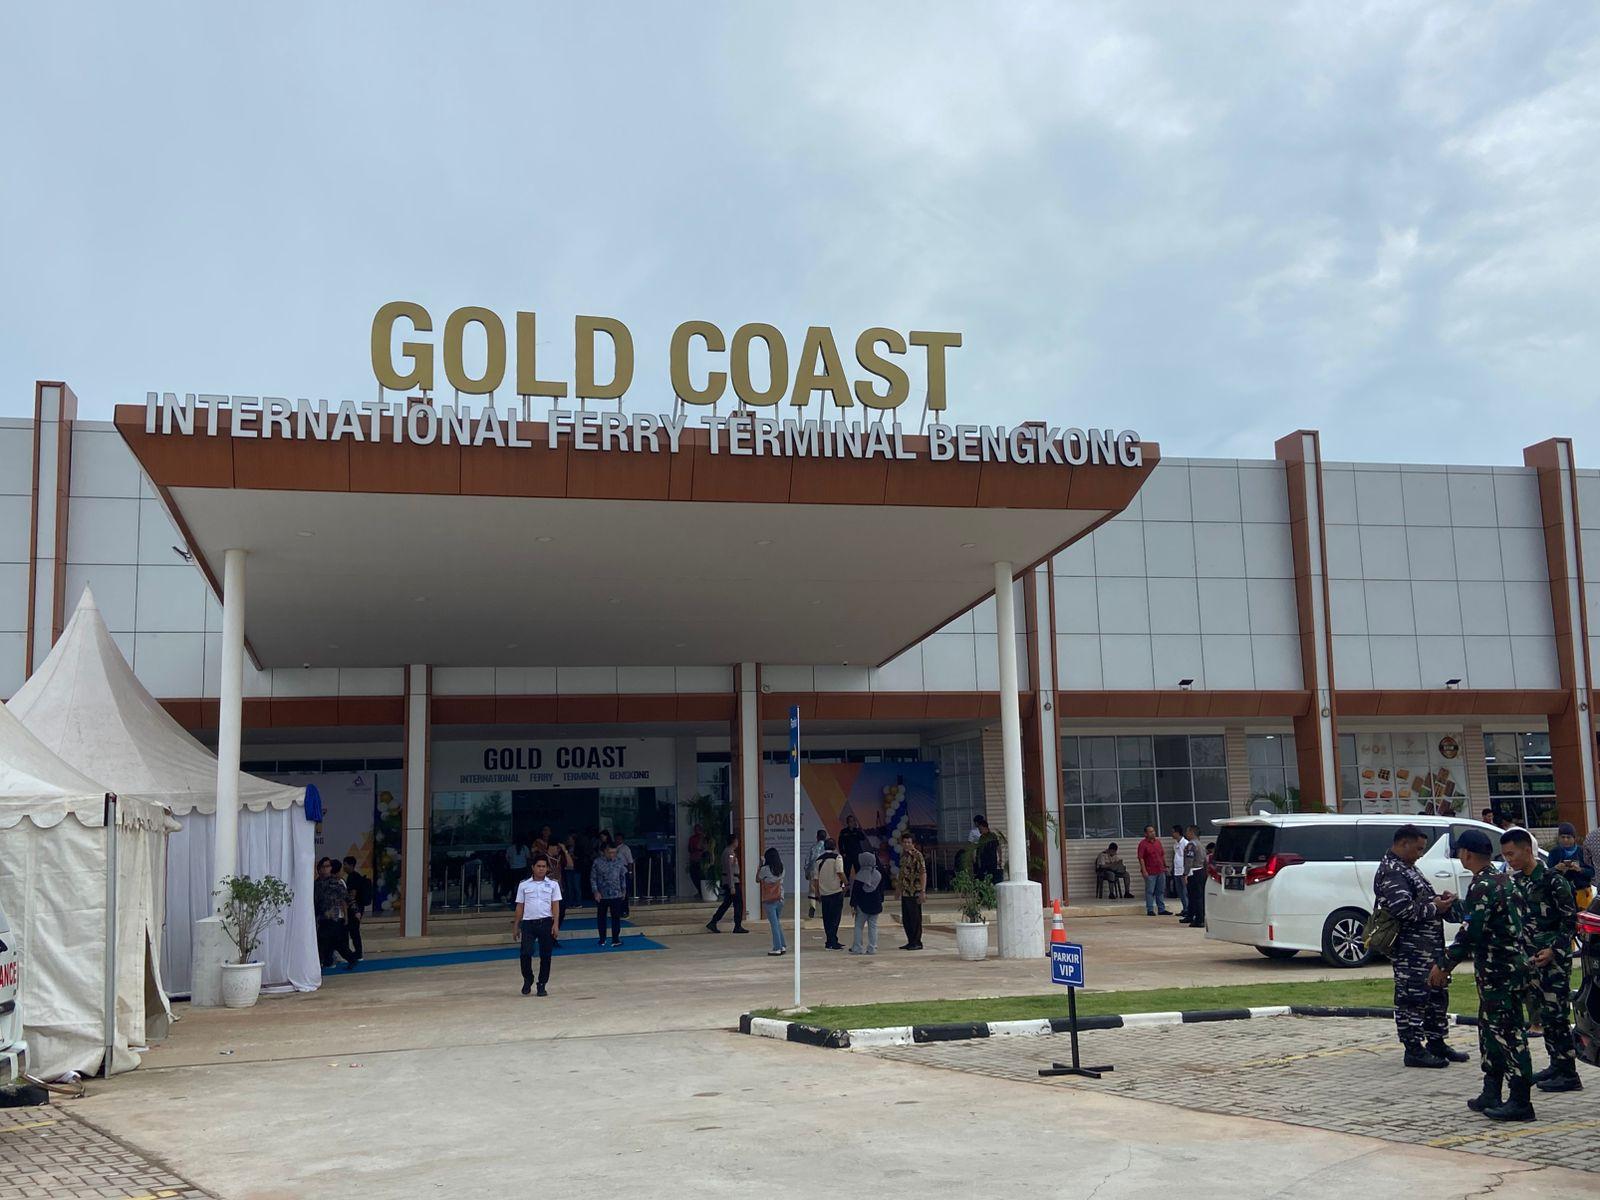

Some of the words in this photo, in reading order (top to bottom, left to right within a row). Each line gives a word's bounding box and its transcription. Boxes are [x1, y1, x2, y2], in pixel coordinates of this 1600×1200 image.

[371, 301, 634, 399] GOLD
[670, 320, 962, 411] COAST
[145, 392, 532, 448] INTERNATIONAL
[549, 410, 687, 453] FERRY
[701, 416, 917, 460] TERMINAL
[929, 423, 1142, 467] BENGKONG
[484, 748, 542, 770] GOLD
[556, 746, 626, 769] COAST
[460, 773, 520, 784] INTERNATIONAL
[530, 773, 553, 782] FERRY
[563, 772, 600, 781] TERMINAL
[609, 771, 650, 780] BENGKONG
[1053, 952, 1080, 964] PARKIR
[1059, 964, 1074, 977] VIP
